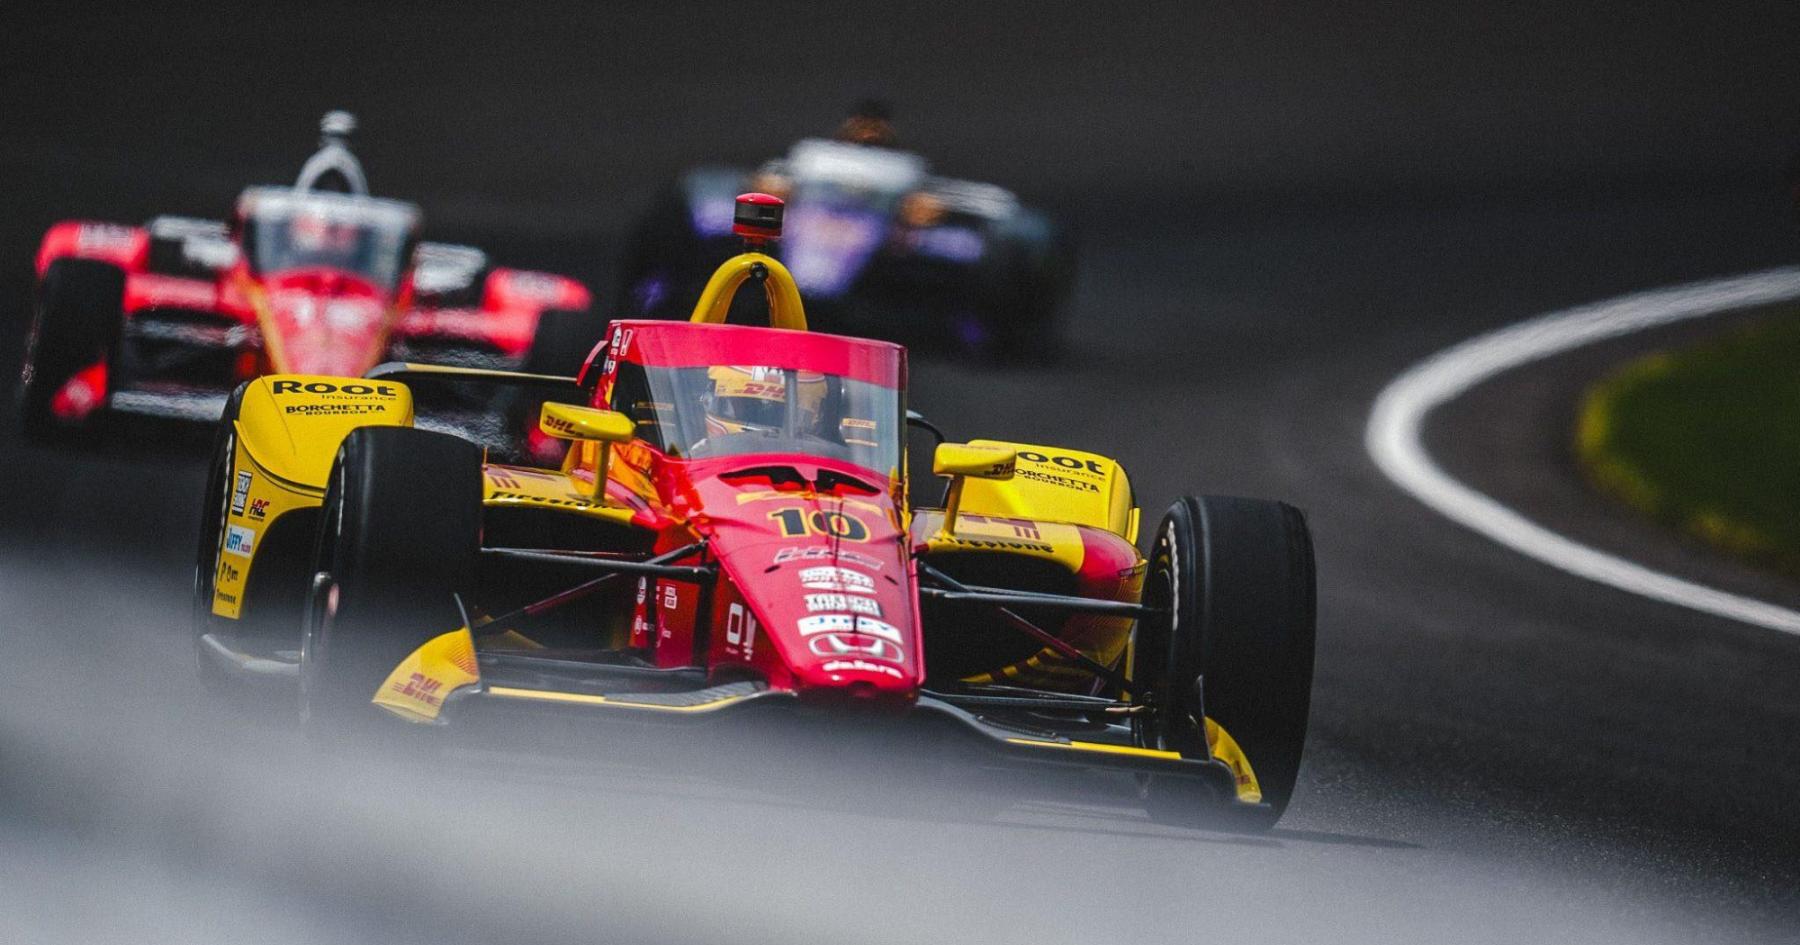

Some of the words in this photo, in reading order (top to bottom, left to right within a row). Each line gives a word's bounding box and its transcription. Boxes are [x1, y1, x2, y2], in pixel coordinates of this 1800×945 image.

[272, 380, 397, 397] Root
[743, 382, 785, 398] DH
[285, 404, 386, 414] BORCHETTA
[543, 415, 577, 433] DHL
[1016, 451, 1105, 476] oot
[1014, 468, 1101, 493] ORCHETTA
[767, 507, 871, 543] 10
